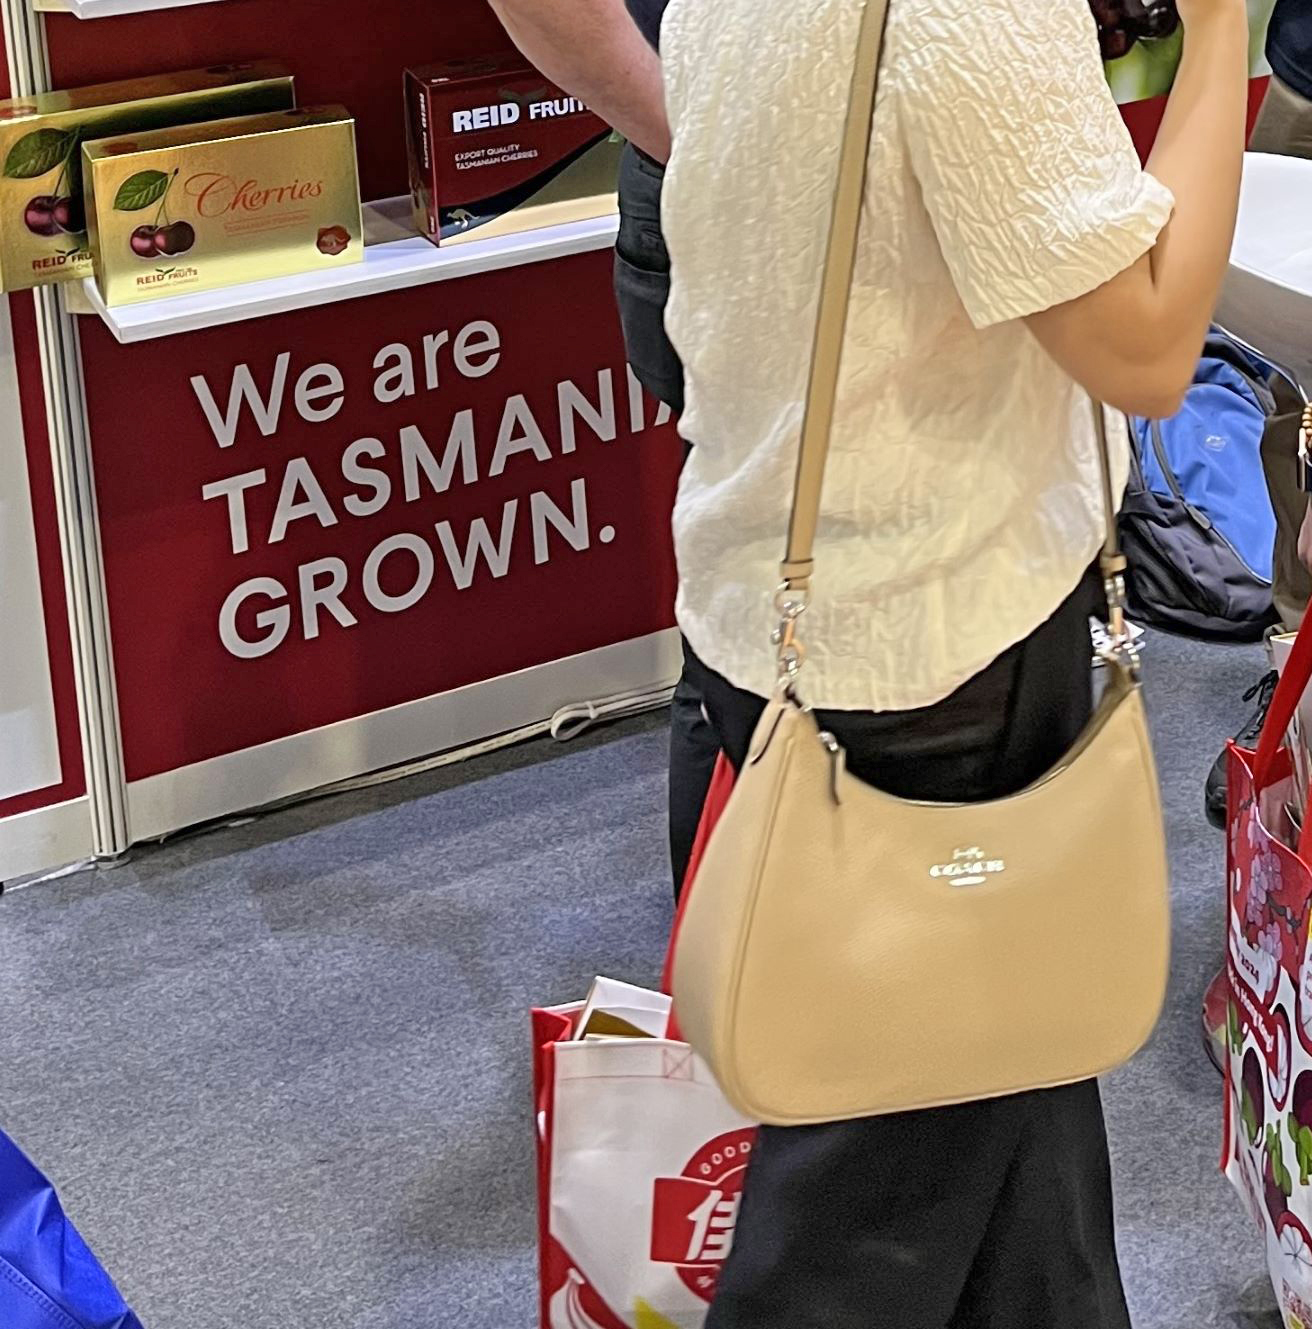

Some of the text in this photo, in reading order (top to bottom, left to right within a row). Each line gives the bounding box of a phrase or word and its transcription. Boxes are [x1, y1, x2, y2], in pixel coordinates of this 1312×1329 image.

[452, 97, 591, 133] REID FRUIT
[455, 143, 520, 162] EXPORT QUALITY
[456, 157, 500, 170] TASMANIAN
[184, 172, 323, 218] Cherries
[32, 255, 67, 271] REID
[71, 252, 95, 263] FRU
[136, 274, 165, 285] REID
[189, 320, 501, 449] We are
[202, 361, 672, 555] TASMANI
[218, 477, 616, 660] GROWN.
